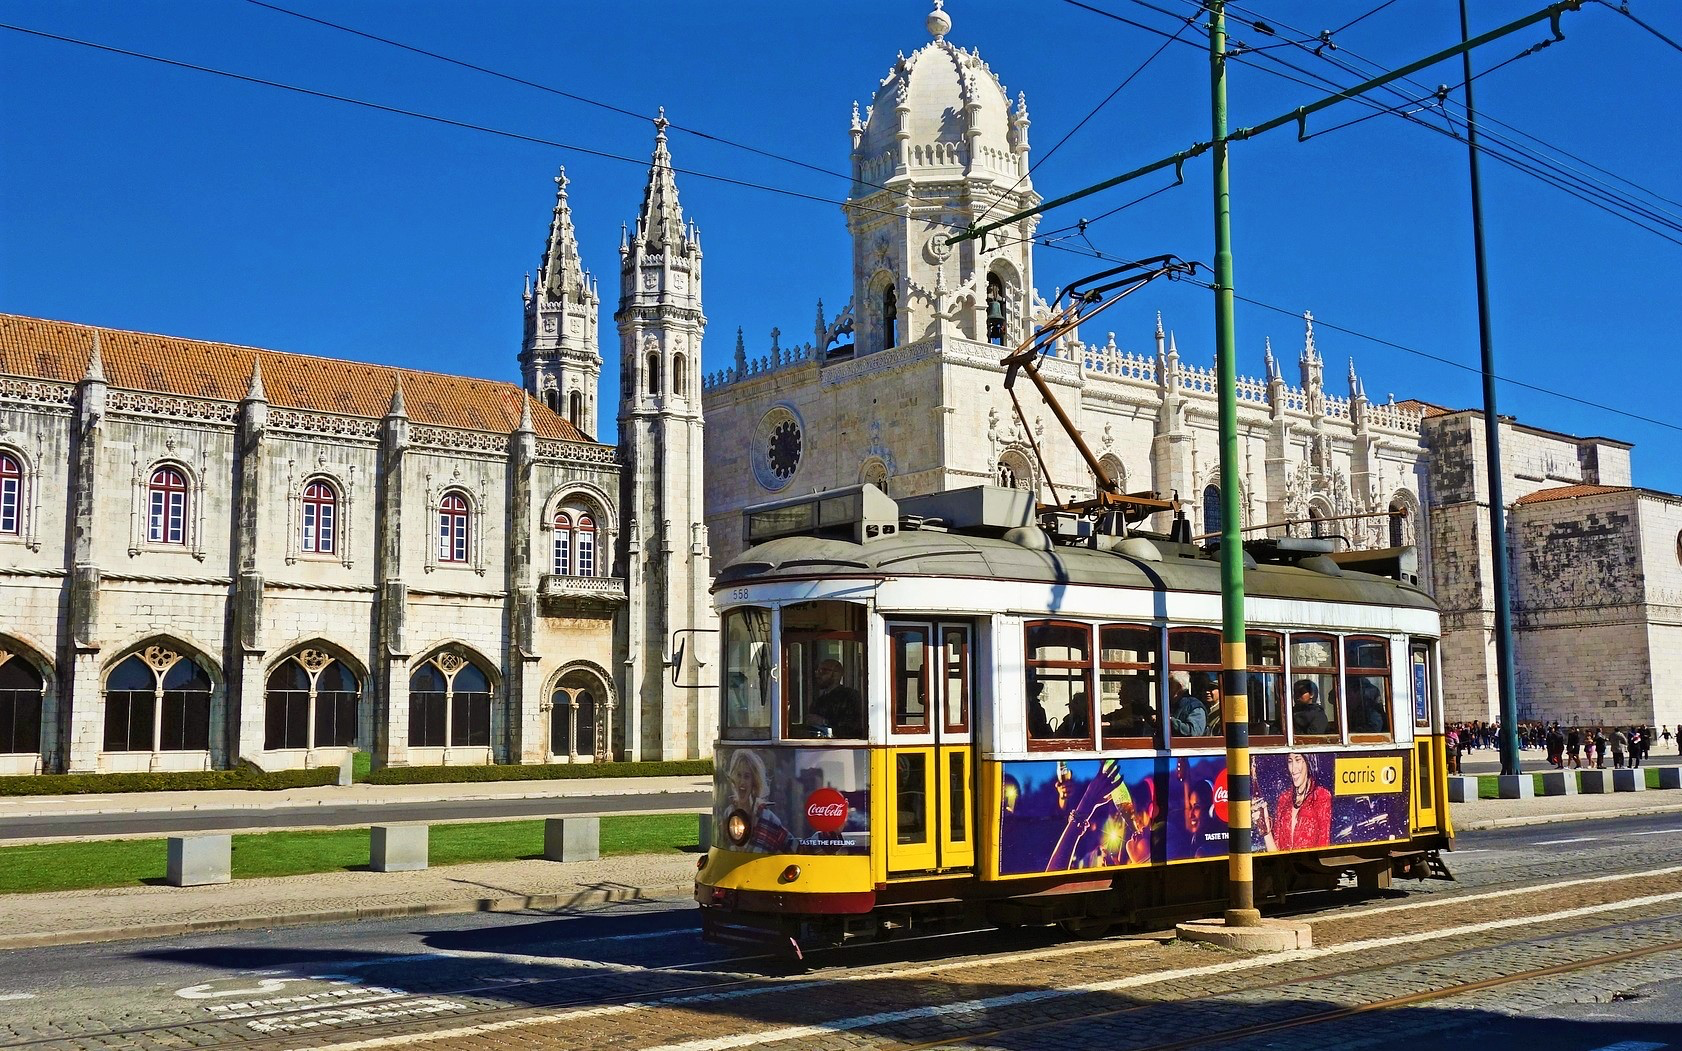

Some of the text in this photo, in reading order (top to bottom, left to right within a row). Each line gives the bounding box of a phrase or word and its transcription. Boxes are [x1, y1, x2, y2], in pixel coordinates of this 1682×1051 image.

[733, 588, 749, 600] 558
[1342, 765, 1375, 784] carris
[807, 803, 845, 817] Coca-Cola
[1204, 832, 1230, 841] TASTE TH
